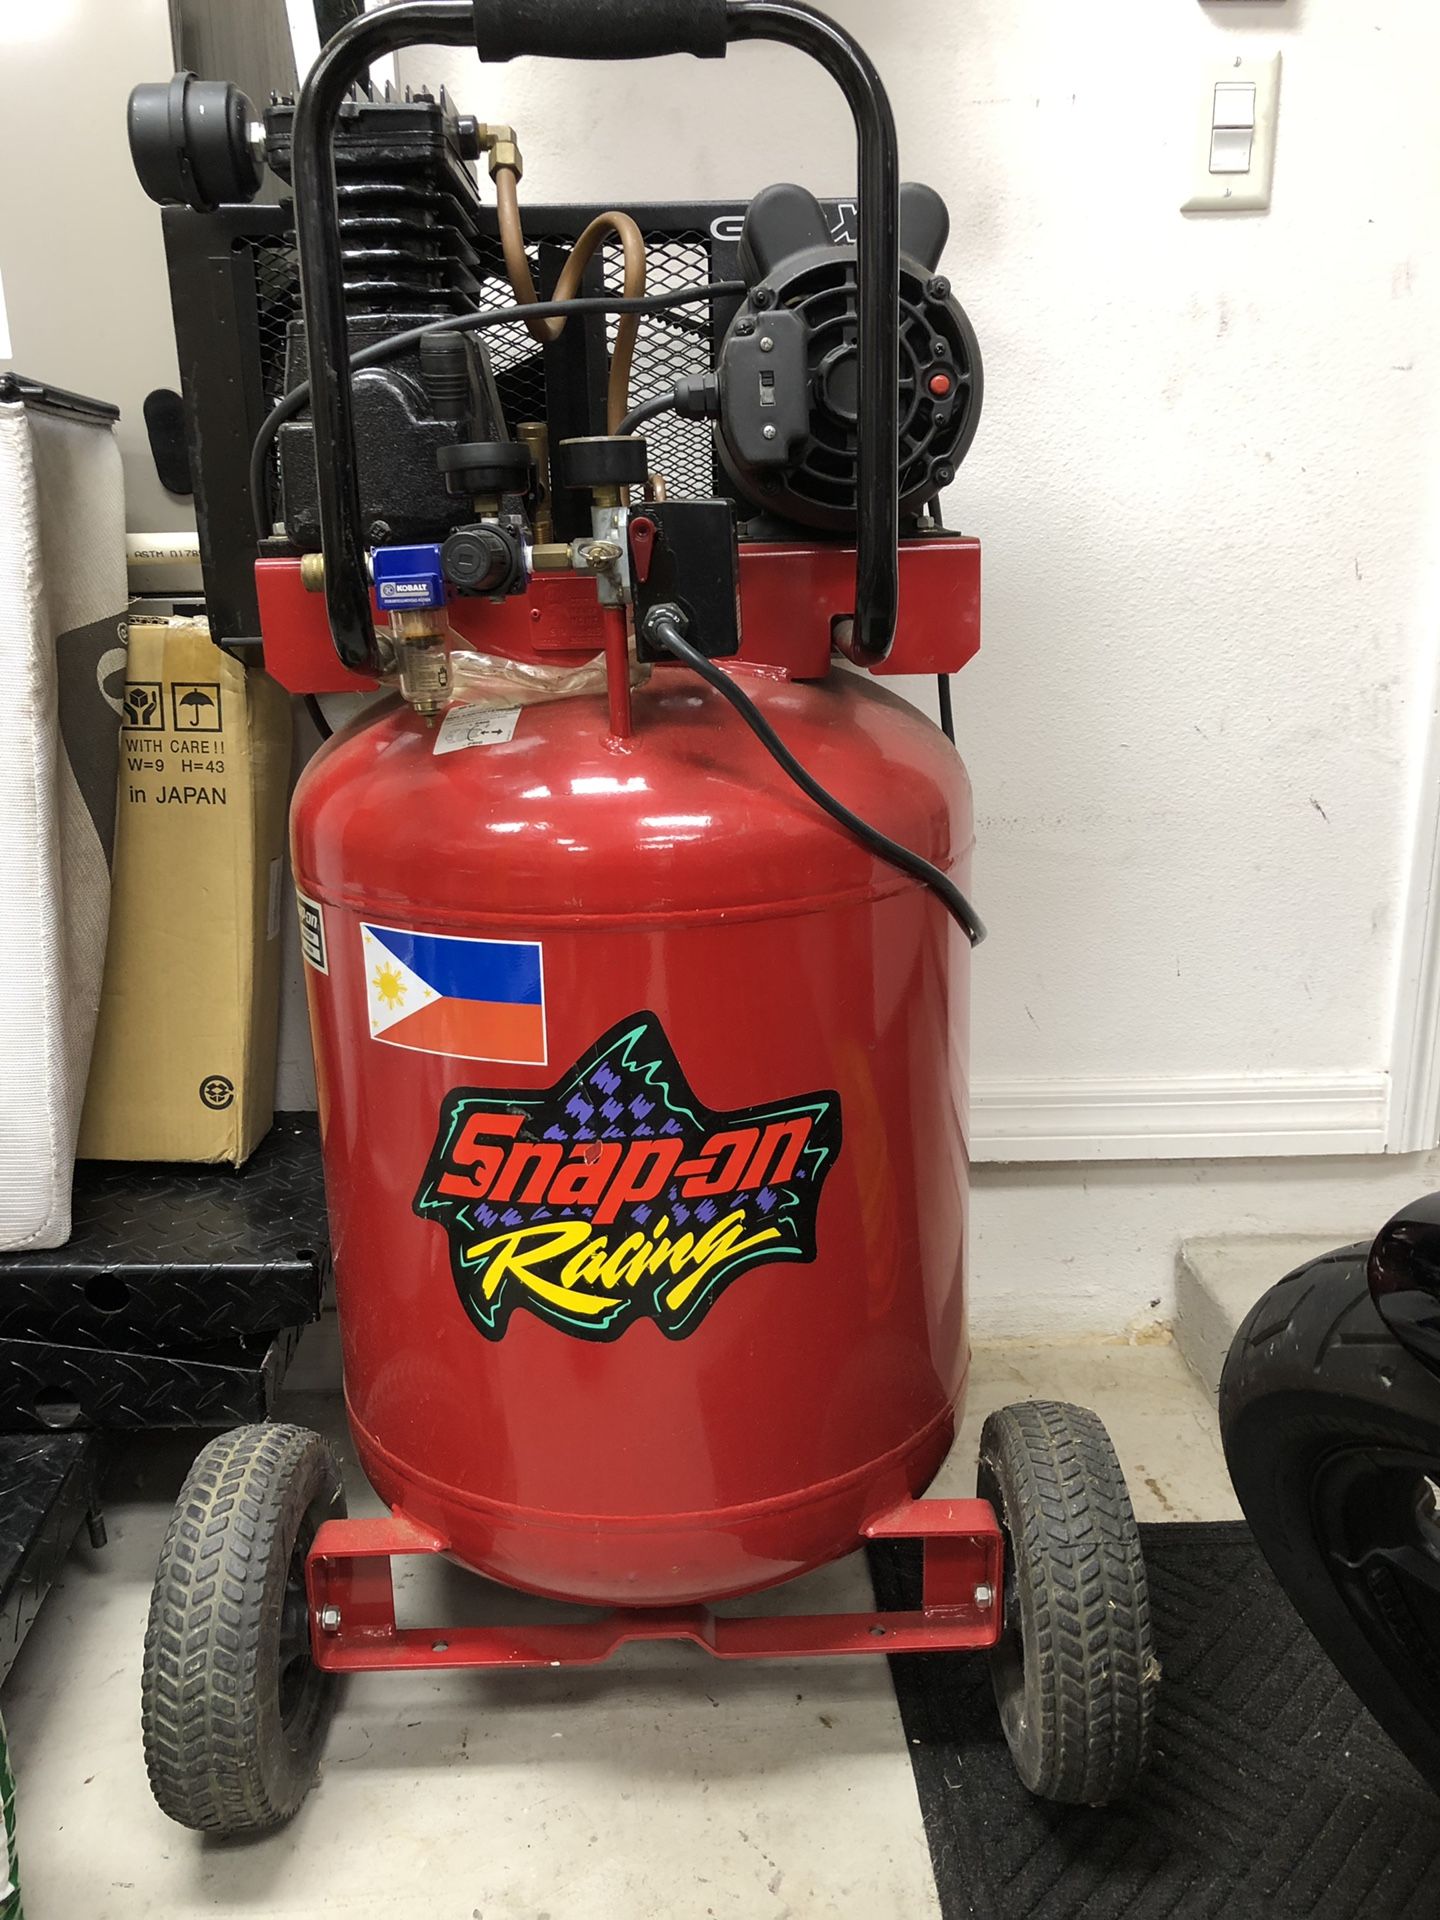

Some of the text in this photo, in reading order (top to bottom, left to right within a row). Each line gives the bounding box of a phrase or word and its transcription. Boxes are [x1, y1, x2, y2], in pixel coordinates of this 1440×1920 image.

[134, 549, 201, 558] ASTM D178
[396, 583, 428, 592] KOBALT
[125, 739, 163, 753] WITH
[127, 758, 225, 773] W=9 H=43
[129, 785, 226, 805] in JAPAN
[437, 1113, 813, 1225] Snap-on
[467, 1210, 781, 1315] Racing
